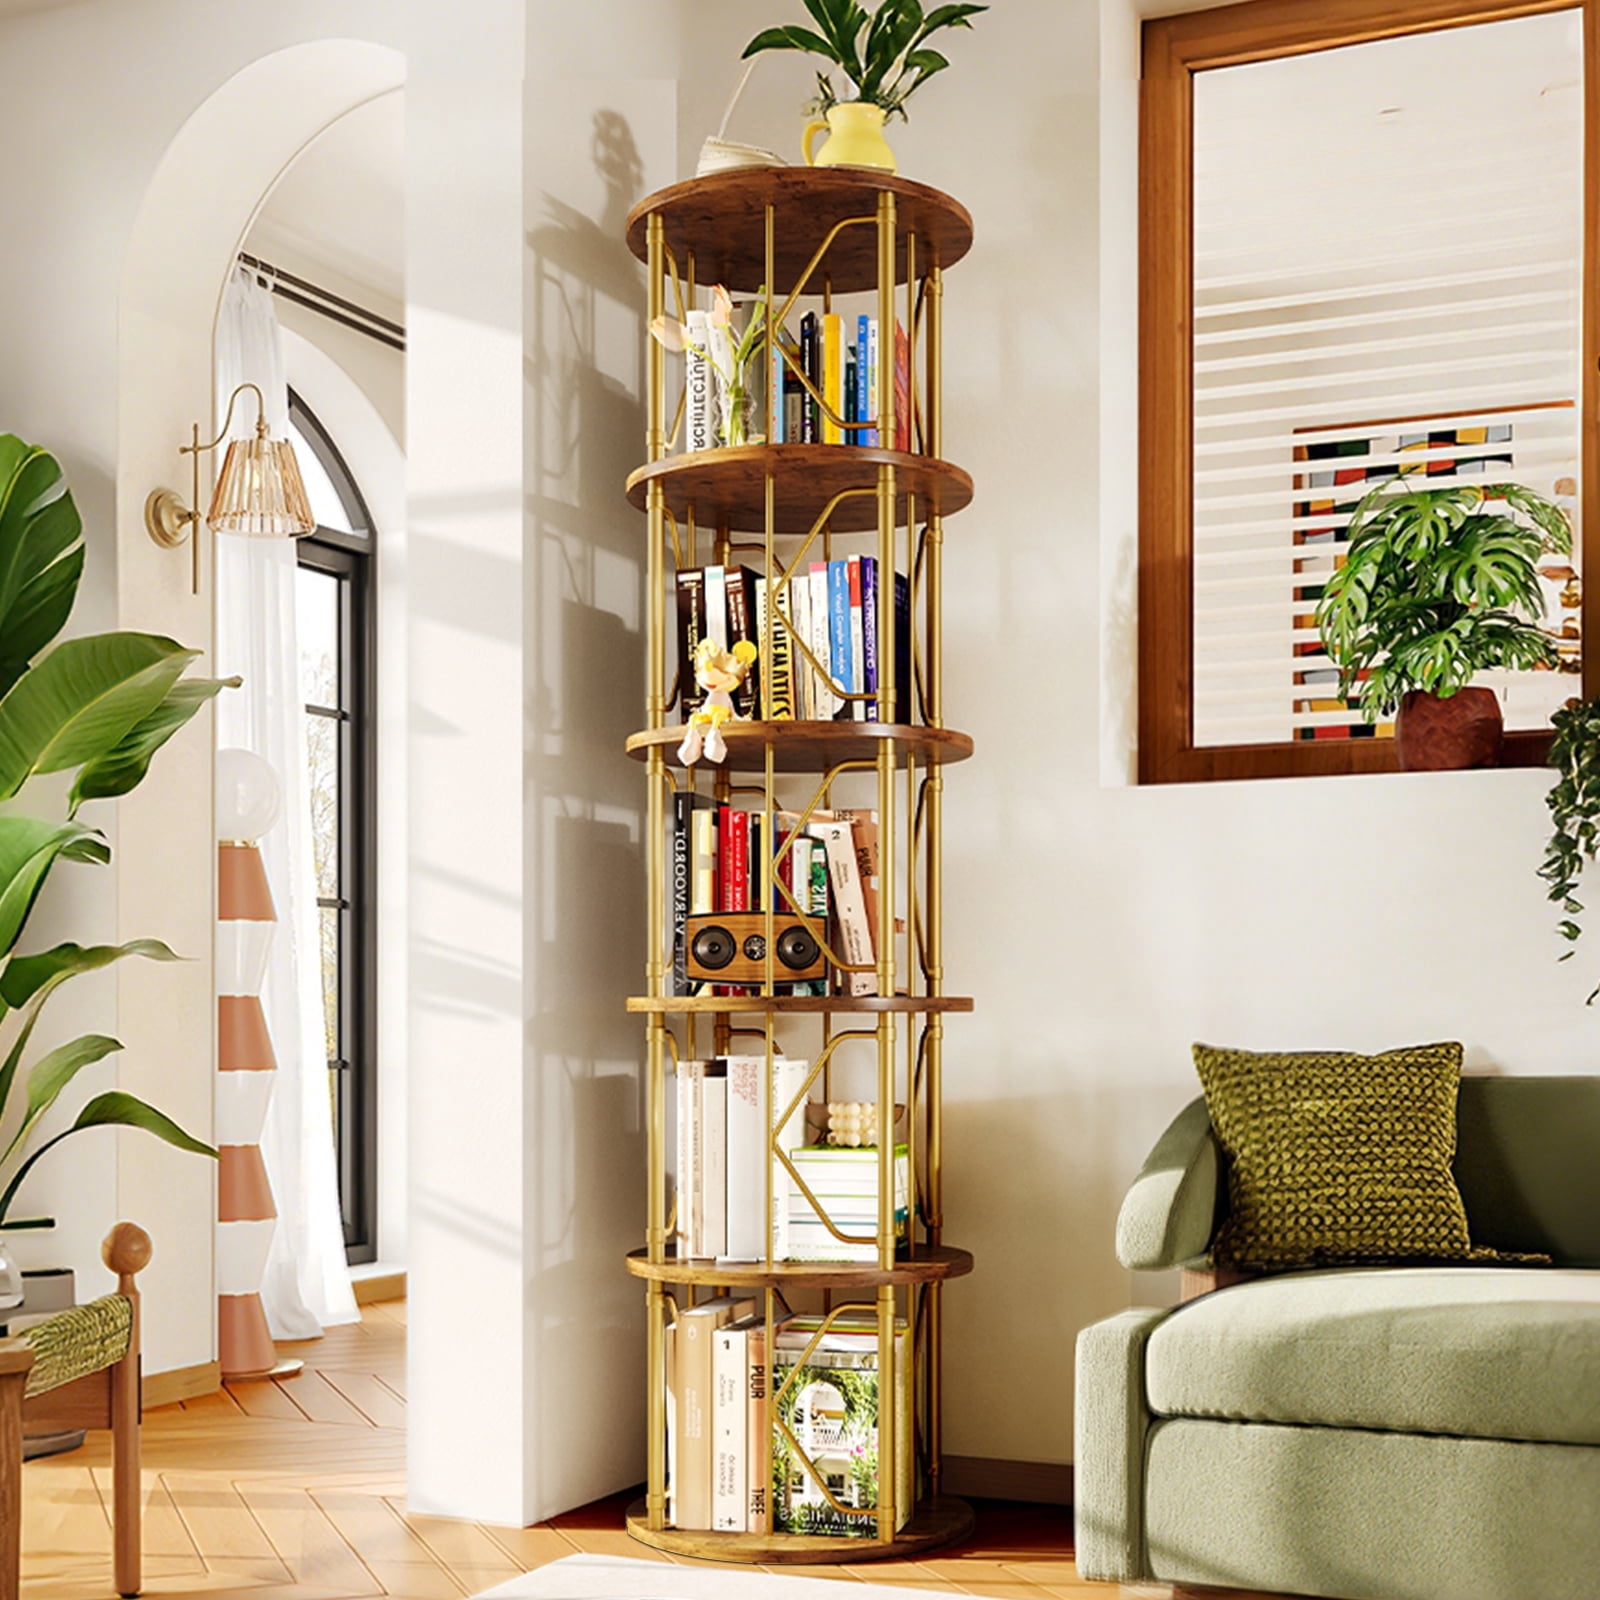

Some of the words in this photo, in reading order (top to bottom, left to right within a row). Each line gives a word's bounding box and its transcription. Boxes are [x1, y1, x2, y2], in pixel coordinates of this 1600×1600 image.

[772, 592, 791, 717] MTHEMATICS
[832, 830, 840, 840] 2
[751, 1365, 765, 1400] PUUR
[751, 1488, 765, 1515] THEE
